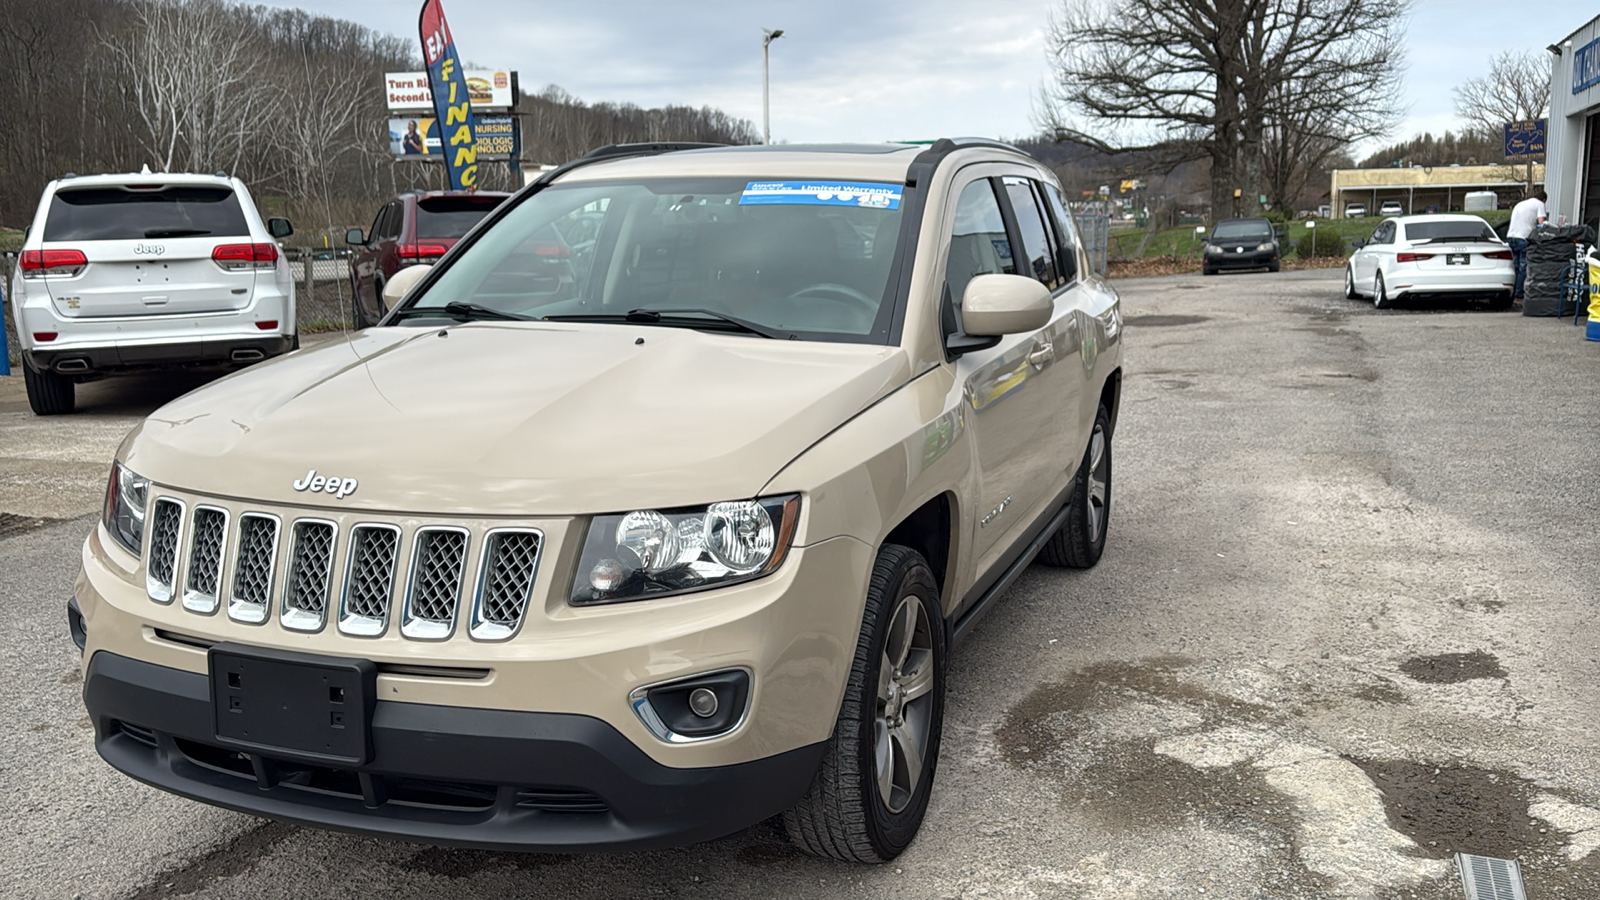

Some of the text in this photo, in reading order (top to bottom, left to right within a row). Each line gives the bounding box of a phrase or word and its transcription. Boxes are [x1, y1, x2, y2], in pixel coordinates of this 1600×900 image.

[388, 79, 414, 89] Turn
[389, 92, 424, 102] Second
[475, 124, 512, 133] NURSING
[801, 184, 894, 195] Limited Warranty
[134, 243, 165, 256] Jeep
[293, 469, 359, 500] Jeep
